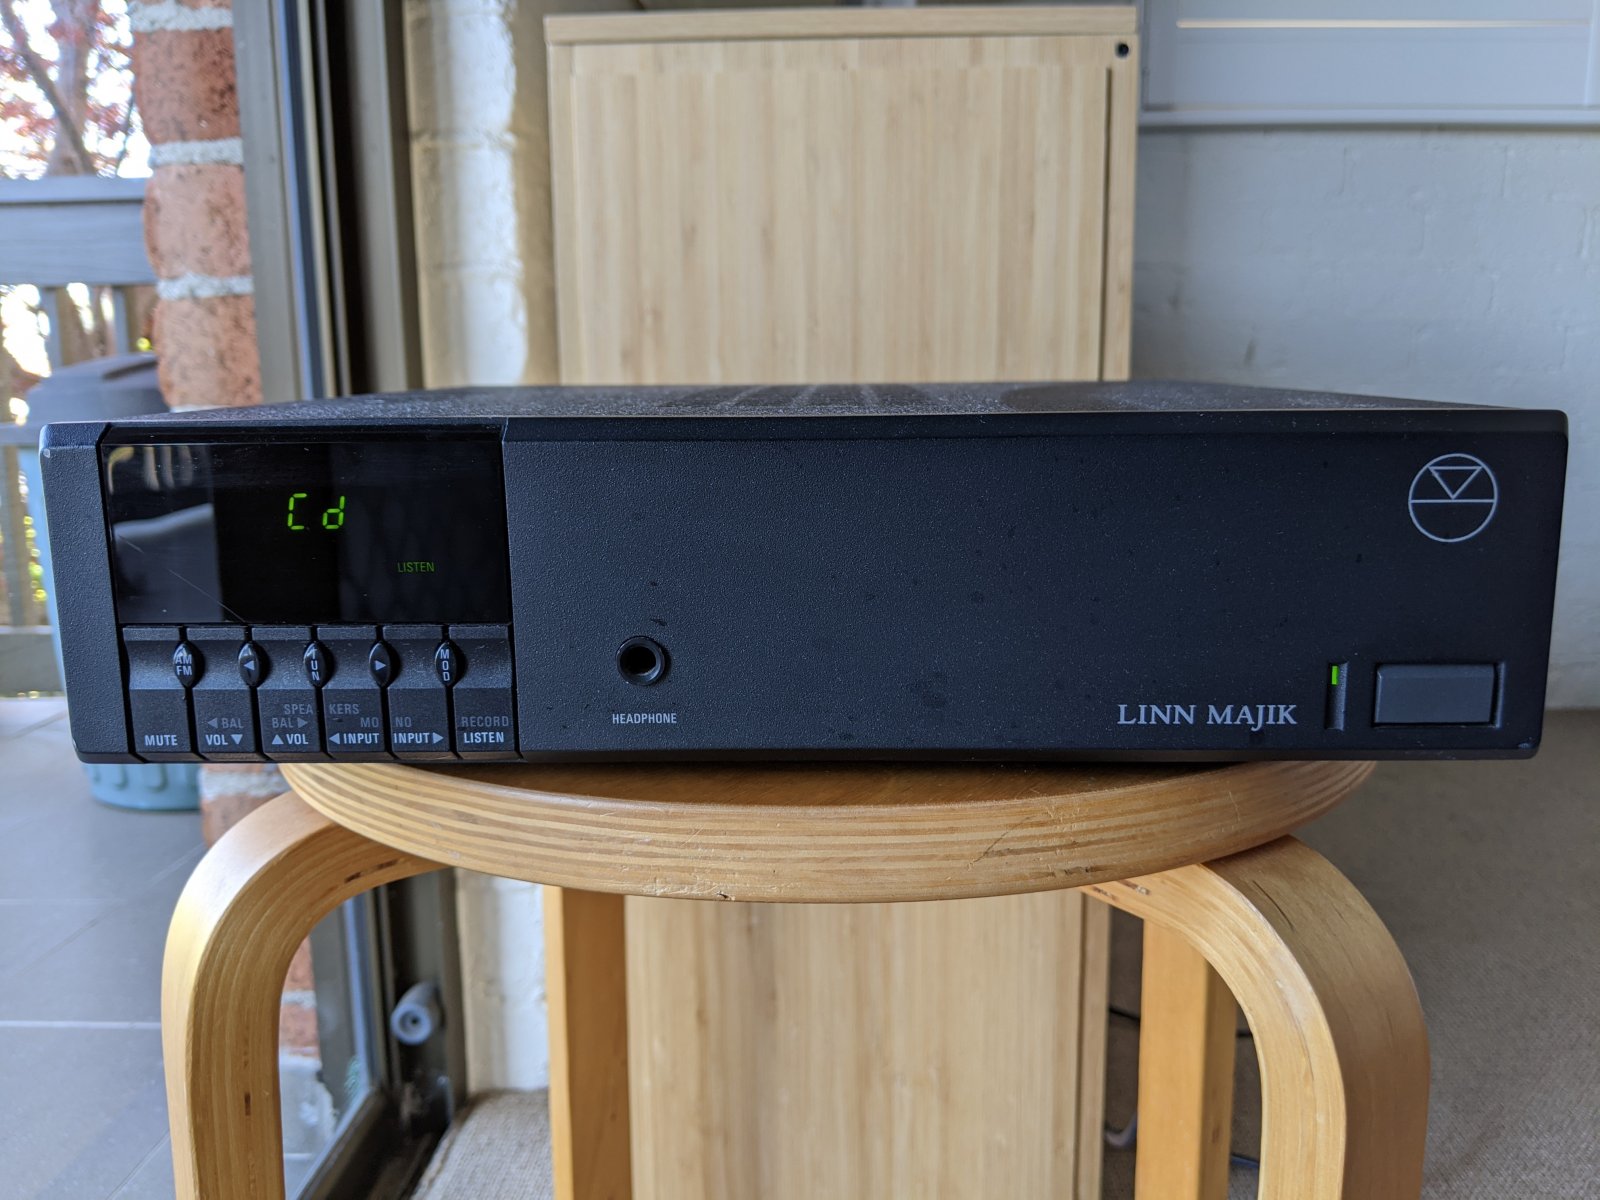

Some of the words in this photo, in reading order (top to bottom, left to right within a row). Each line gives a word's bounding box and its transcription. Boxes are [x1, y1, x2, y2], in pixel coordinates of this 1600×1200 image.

[397, 561, 435, 573] LISTEN
[175, 654, 192, 665] AM
[310, 649, 320, 682] TUN
[440, 649, 450, 682] MOD
[176, 666, 192, 676] FM
[221, 718, 244, 730] BAL
[272, 717, 294, 729] BAL
[461, 716, 509, 729] RECORD
[612, 713, 678, 725] HEADPHONE
[1117, 704, 1196, 725] LINN
[1206, 704, 1297, 732] MAJIK
[144, 734, 178, 747] MUTE
[205, 734, 229, 746] VOL
[286, 734, 309, 746] VOL
[343, 733, 380, 745] INPUT
[393, 733, 430, 745] INPUT
[463, 732, 505, 744] LISTEN
